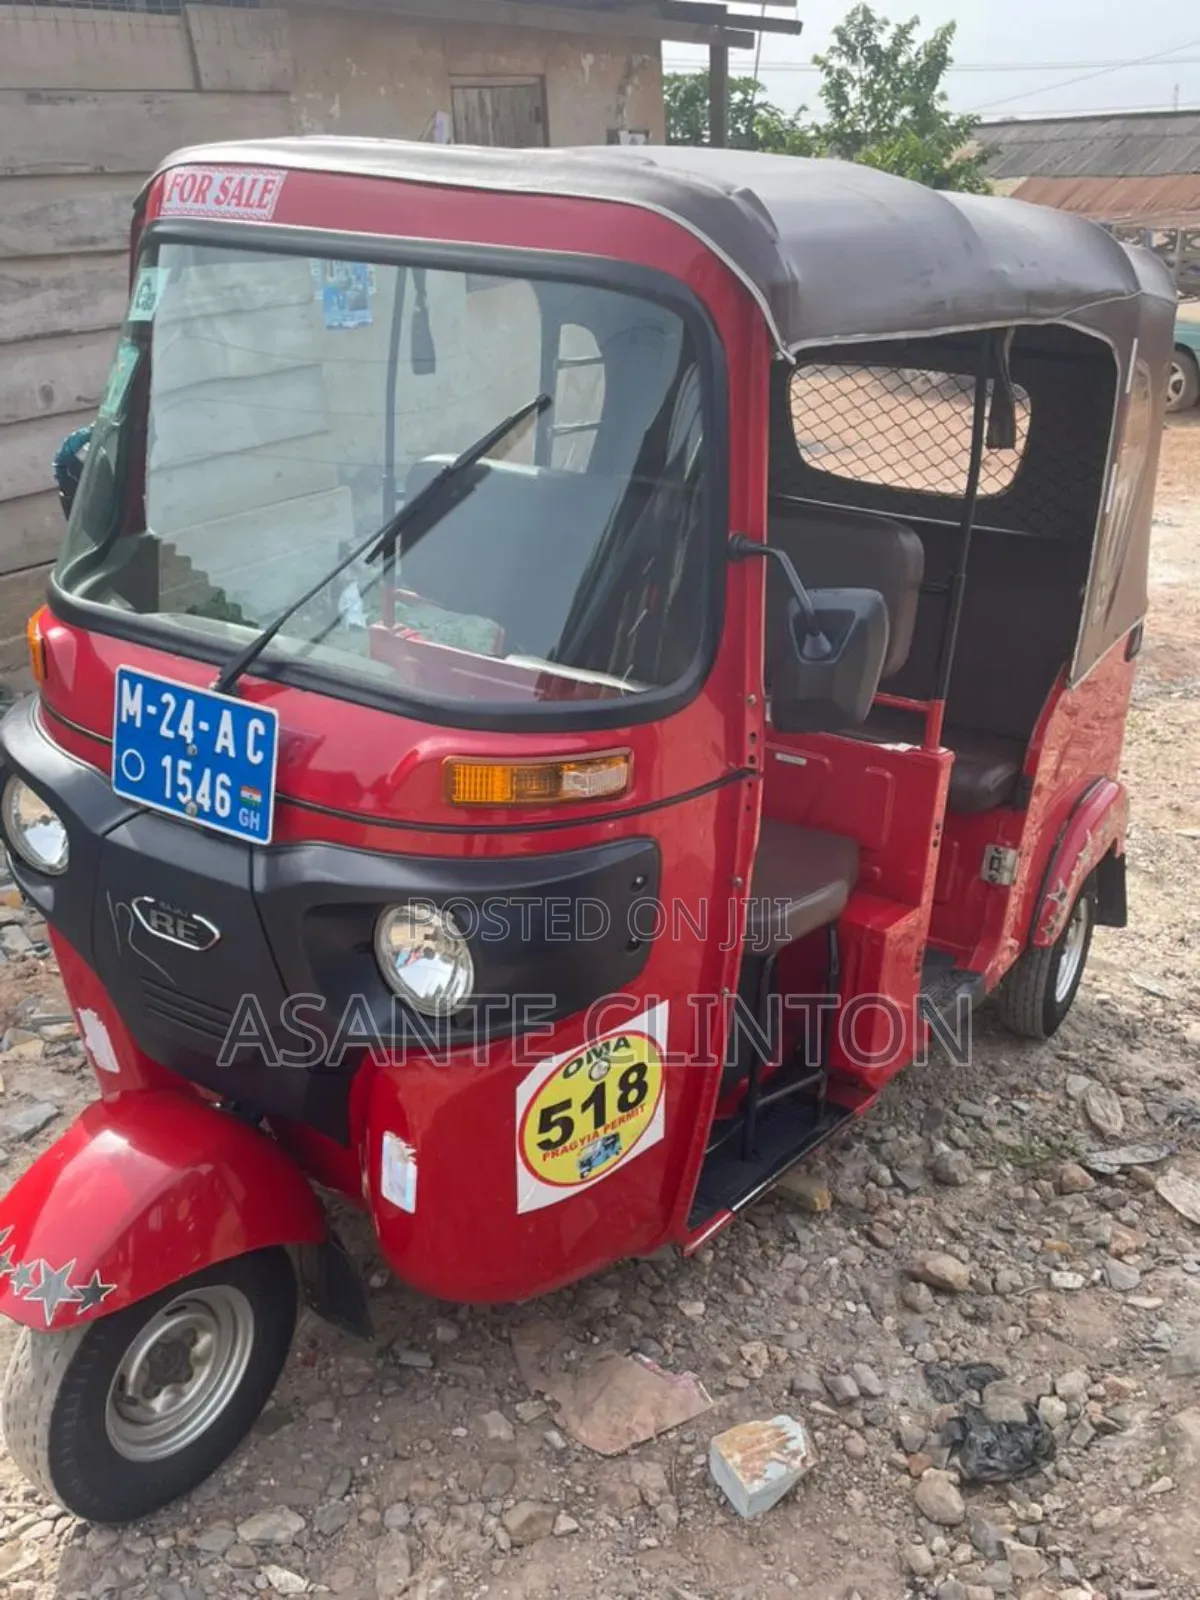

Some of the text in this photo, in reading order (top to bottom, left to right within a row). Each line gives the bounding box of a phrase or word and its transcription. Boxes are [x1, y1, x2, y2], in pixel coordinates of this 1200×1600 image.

[166, 173, 276, 209] FOR SALE
[161, 755, 232, 818] 1546
[238, 808, 260, 831] GH
[150, 909, 200, 945] RE
[562, 1036, 631, 1079] OMA
[536, 1062, 648, 1151] 518
[603, 1102, 646, 1134] PERMIT
